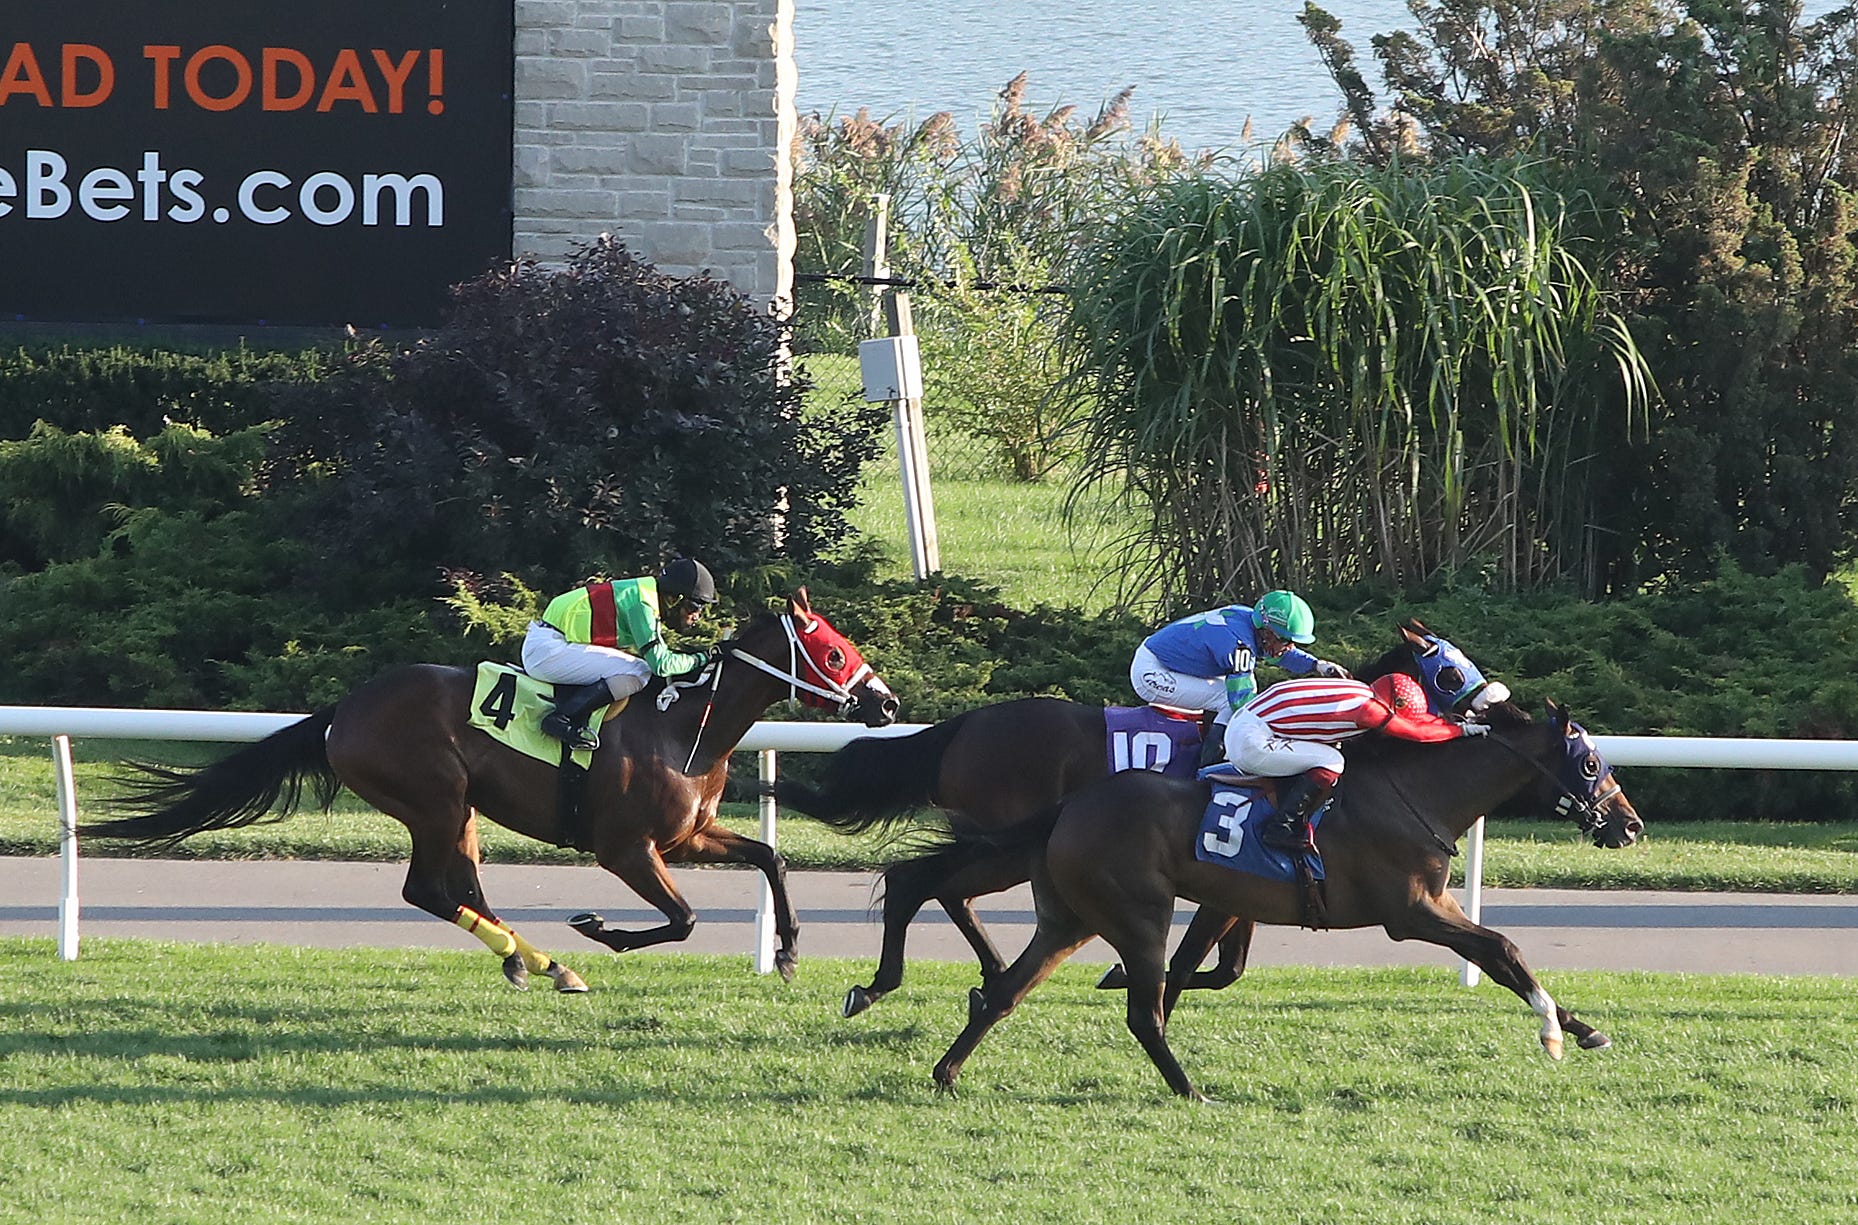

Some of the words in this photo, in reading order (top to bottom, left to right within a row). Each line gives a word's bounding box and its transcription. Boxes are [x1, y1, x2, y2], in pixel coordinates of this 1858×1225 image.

[0, 42, 116, 108] AD
[143, 45, 445, 116] TODAY!
[1235, 649, 1251, 672] 10
[479, 672, 518, 730] 4
[1113, 731, 1172, 773] 10
[1202, 791, 1253, 858] 3
